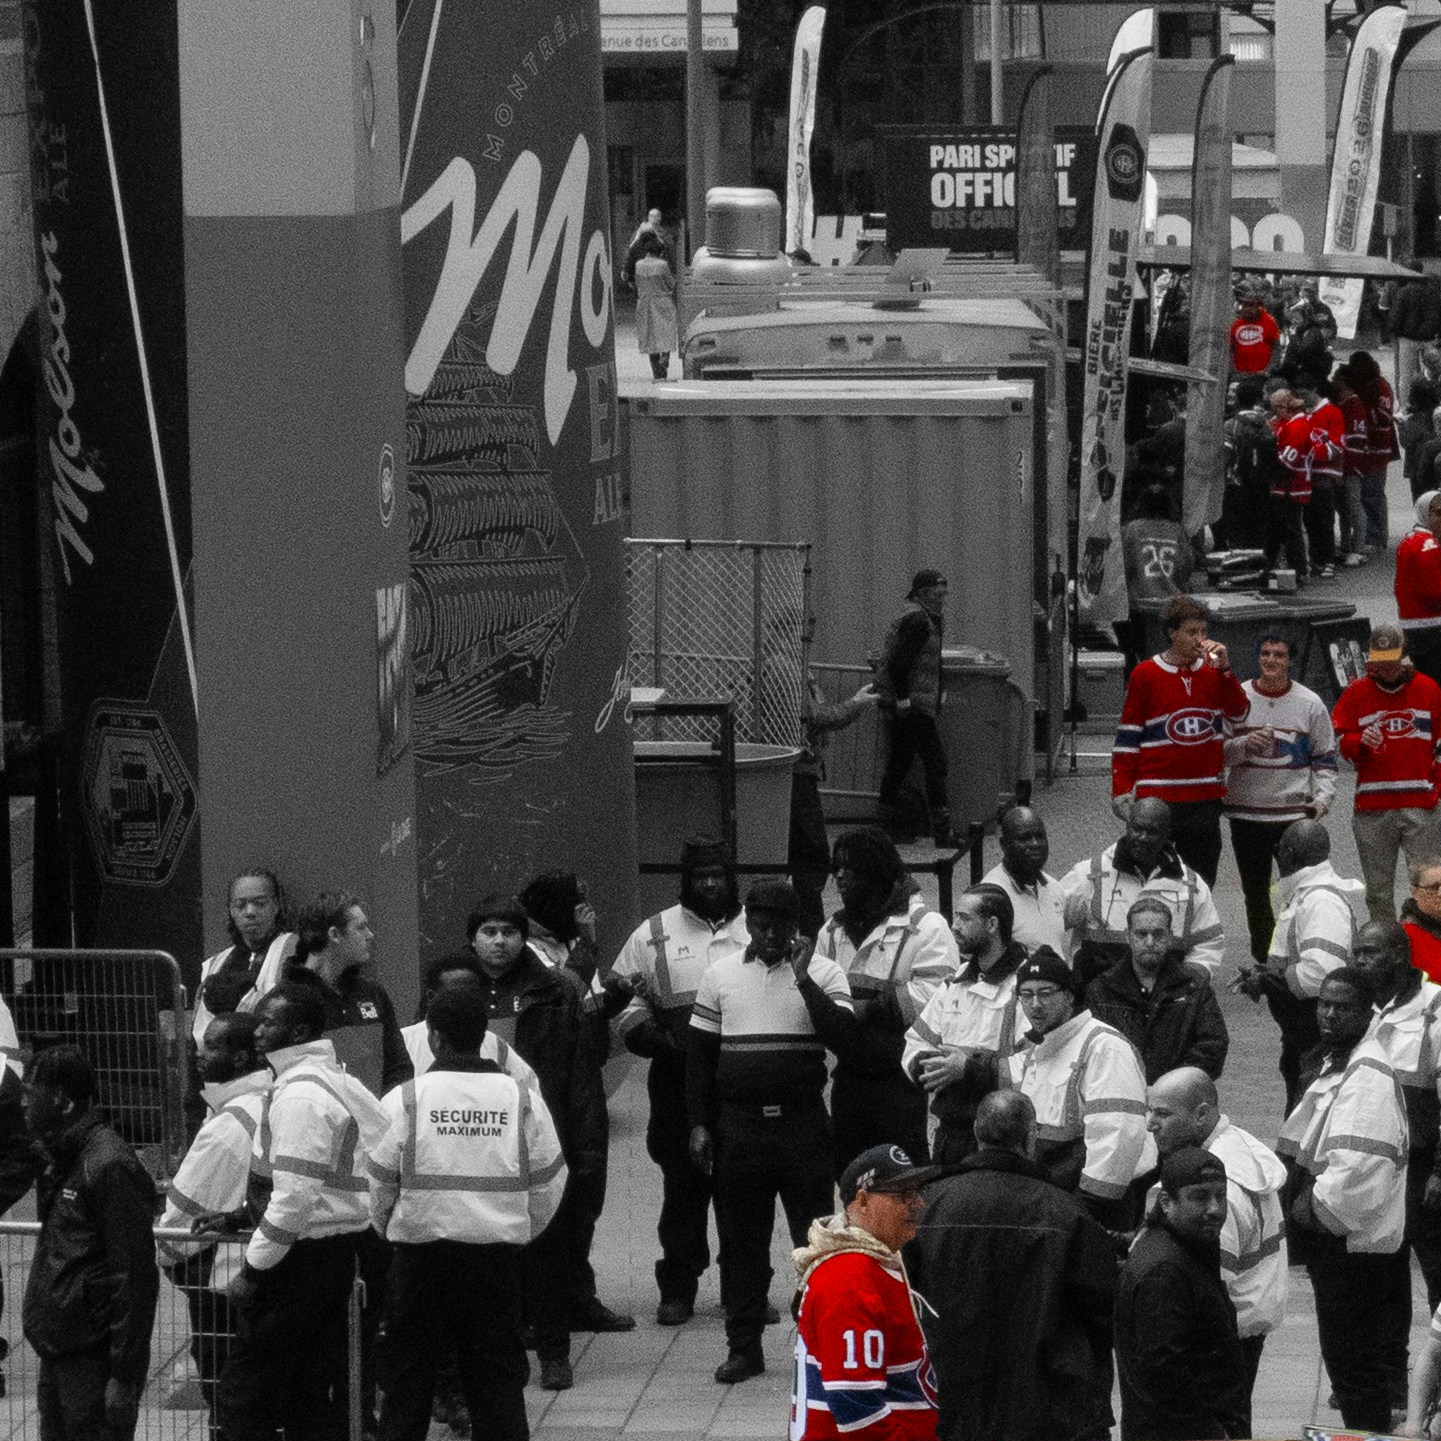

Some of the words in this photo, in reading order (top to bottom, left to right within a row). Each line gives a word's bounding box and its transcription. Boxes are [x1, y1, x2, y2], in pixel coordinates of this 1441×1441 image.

[602, 36, 632, 48] enue
[635, 33, 659, 48] des
[661, 34, 729, 48] Caniens
[50, 123, 70, 205] ALE
[930, 144, 980, 168] PARI
[985, 143, 1076, 168] SPIF
[930, 171, 1077, 208] OFFIL
[42, 231, 105, 586] Molson
[429, 1108, 509, 1126] SÉCURITÉ
[436, 1126, 502, 1138] MAXIMUM
[843, 1328, 885, 1369] 10
